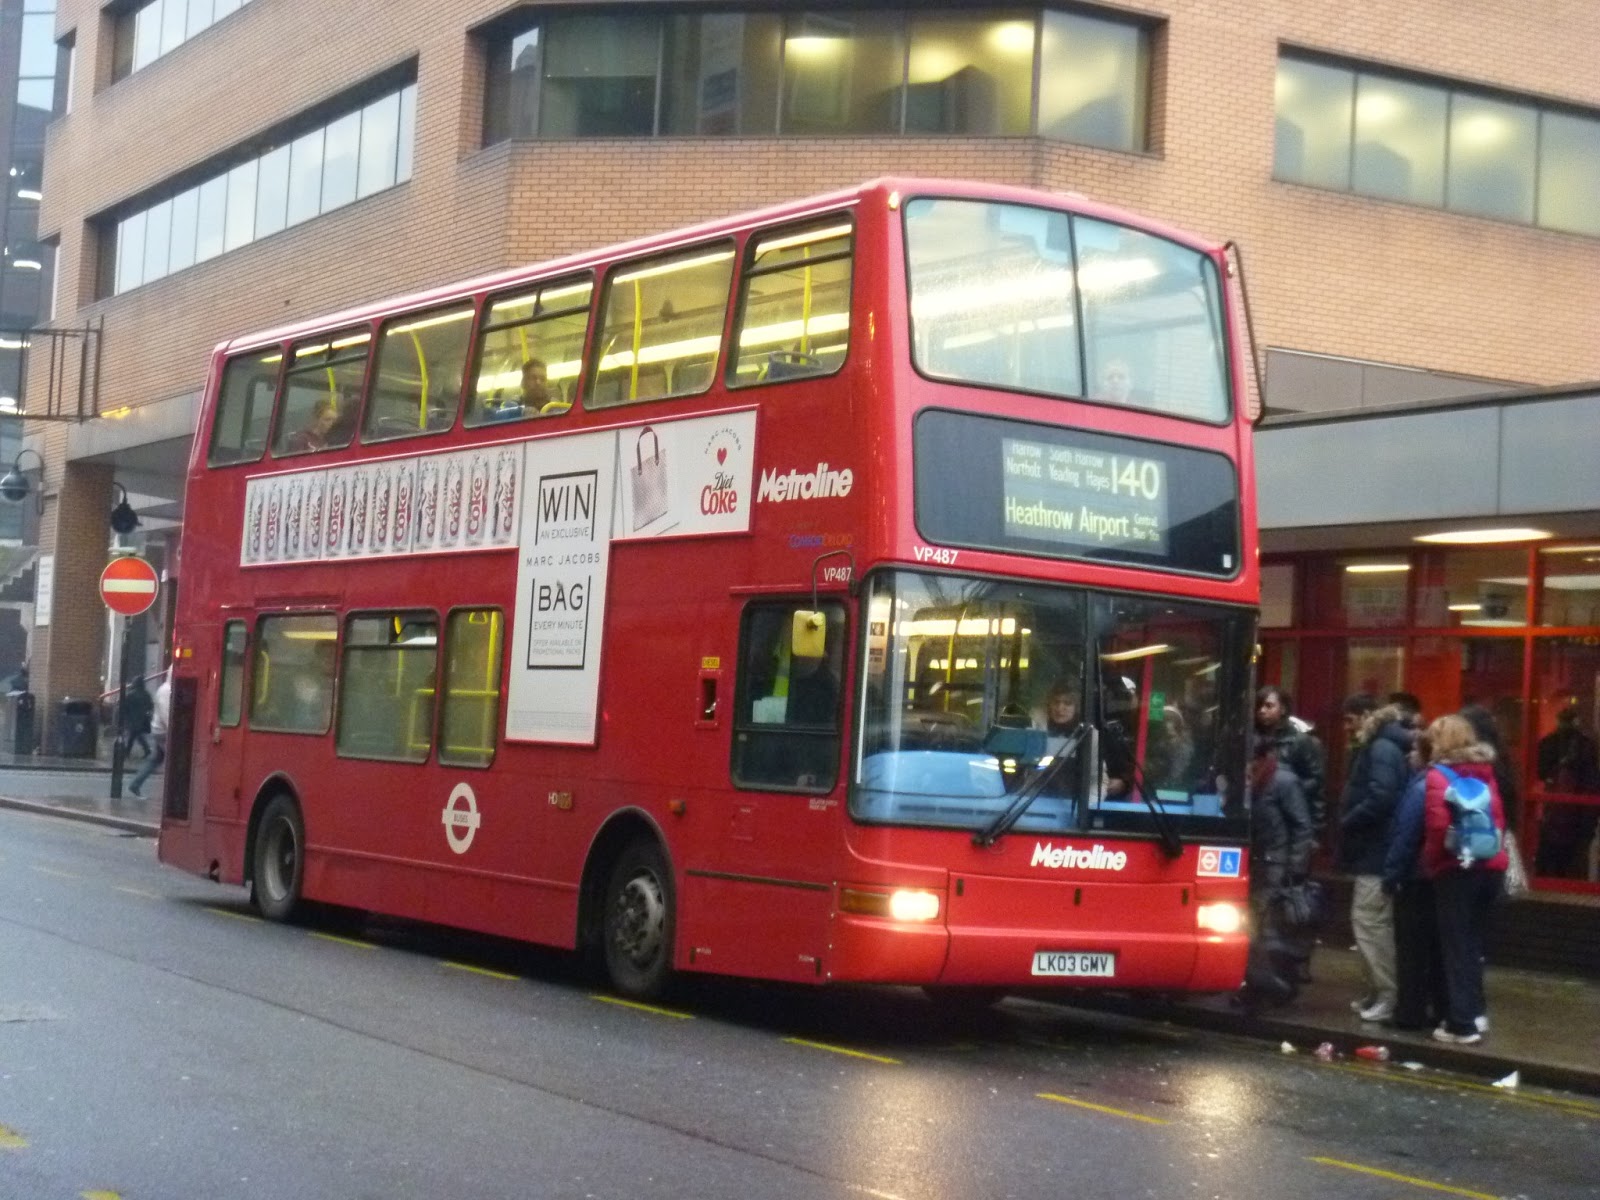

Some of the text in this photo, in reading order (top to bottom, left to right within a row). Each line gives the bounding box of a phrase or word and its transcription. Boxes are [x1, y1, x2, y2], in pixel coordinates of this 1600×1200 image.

[1050, 447, 1072, 464] South
[713, 471, 734, 491] Diet
[757, 462, 853, 503] Metroline
[1006, 456, 1110, 491] Northolt Yeading Hayes
[1111, 456, 1160, 500] 140
[394, 486, 407, 542] Coke
[468, 477, 482, 535] Coke
[543, 483, 591, 523] WIN
[700, 484, 738, 516] Coke
[328, 494, 341, 547] Coke
[1005, 496, 1129, 541] Heathrow Airport
[540, 527, 589, 540] AN EXCLUSIVE
[526, 553, 600, 567] MARC JACOBS
[914, 546, 959, 565] VP487
[824, 567, 852, 582] VP487
[538, 583, 583, 612] BAG
[534, 620, 584, 630] EVERY MINUTE
[454, 814, 468, 823] BUSES
[1030, 841, 1127, 871] Metroline
[1038, 954, 1109, 972] LK03 GMV
